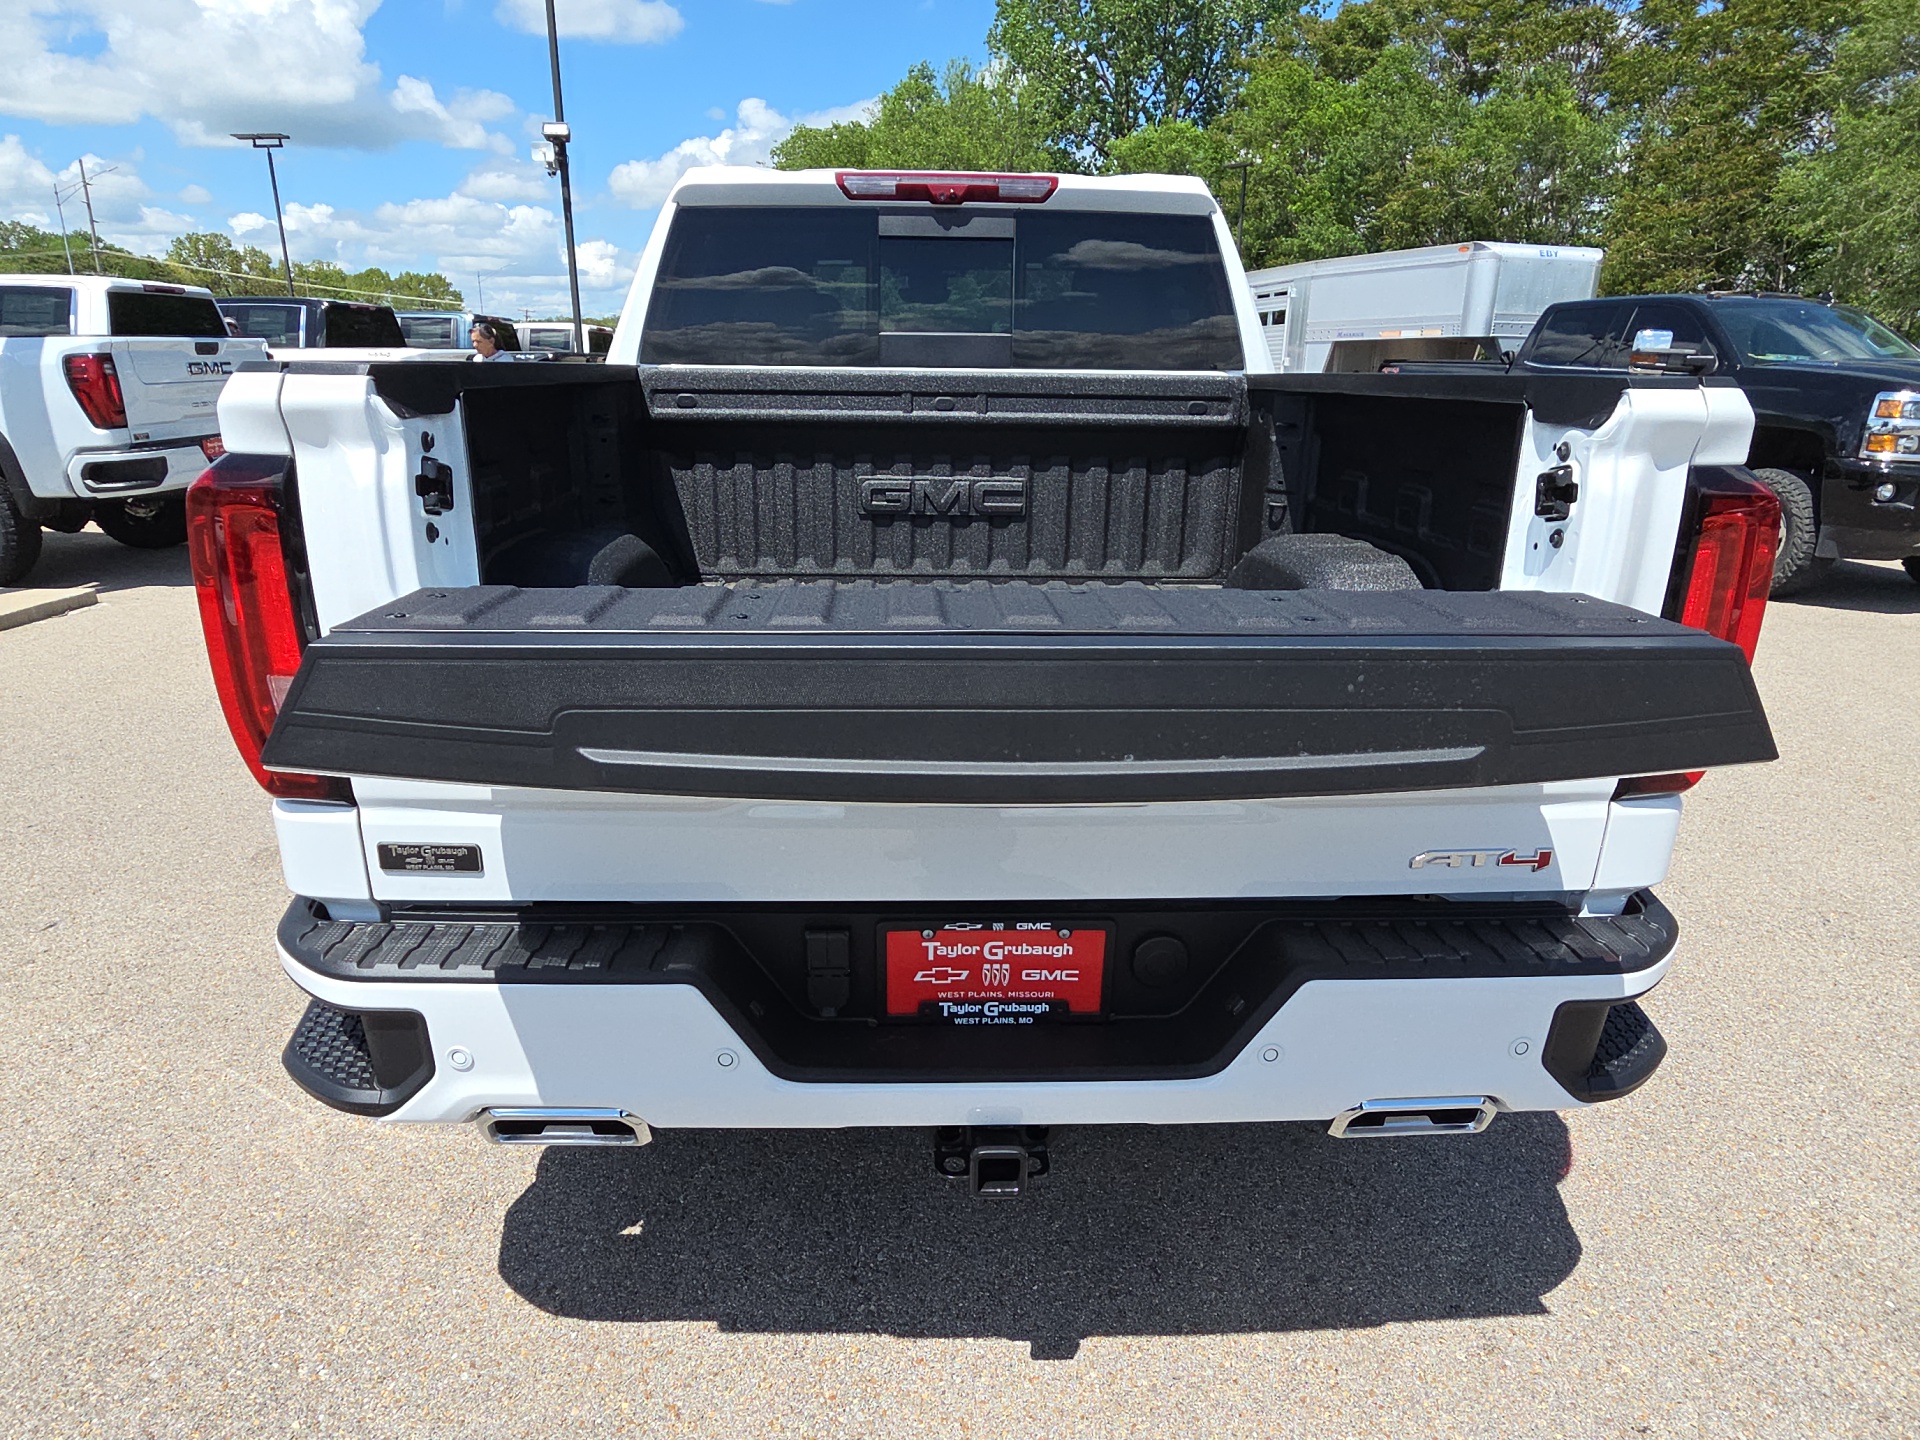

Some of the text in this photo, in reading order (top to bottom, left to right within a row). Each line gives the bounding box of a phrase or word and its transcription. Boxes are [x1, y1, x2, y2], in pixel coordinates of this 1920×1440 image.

[1539, 249, 1558, 258] EBY
[186, 361, 233, 376] GMC
[860, 480, 1025, 514] GMC
[388, 845, 468, 857] Taylor Grubaugh
[1409, 848, 1554, 872] AT4
[1016, 922, 1051, 930] GMC
[921, 941, 1073, 961] Taylor Grubaugh
[1021, 970, 1080, 981] GMC
[968, 991, 1005, 999] PLAINS,
[938, 1002, 1050, 1017] Taylor Grubaugh
[954, 1017, 980, 1025] WEST
[982, 1017, 1016, 1025] PLAINS,
